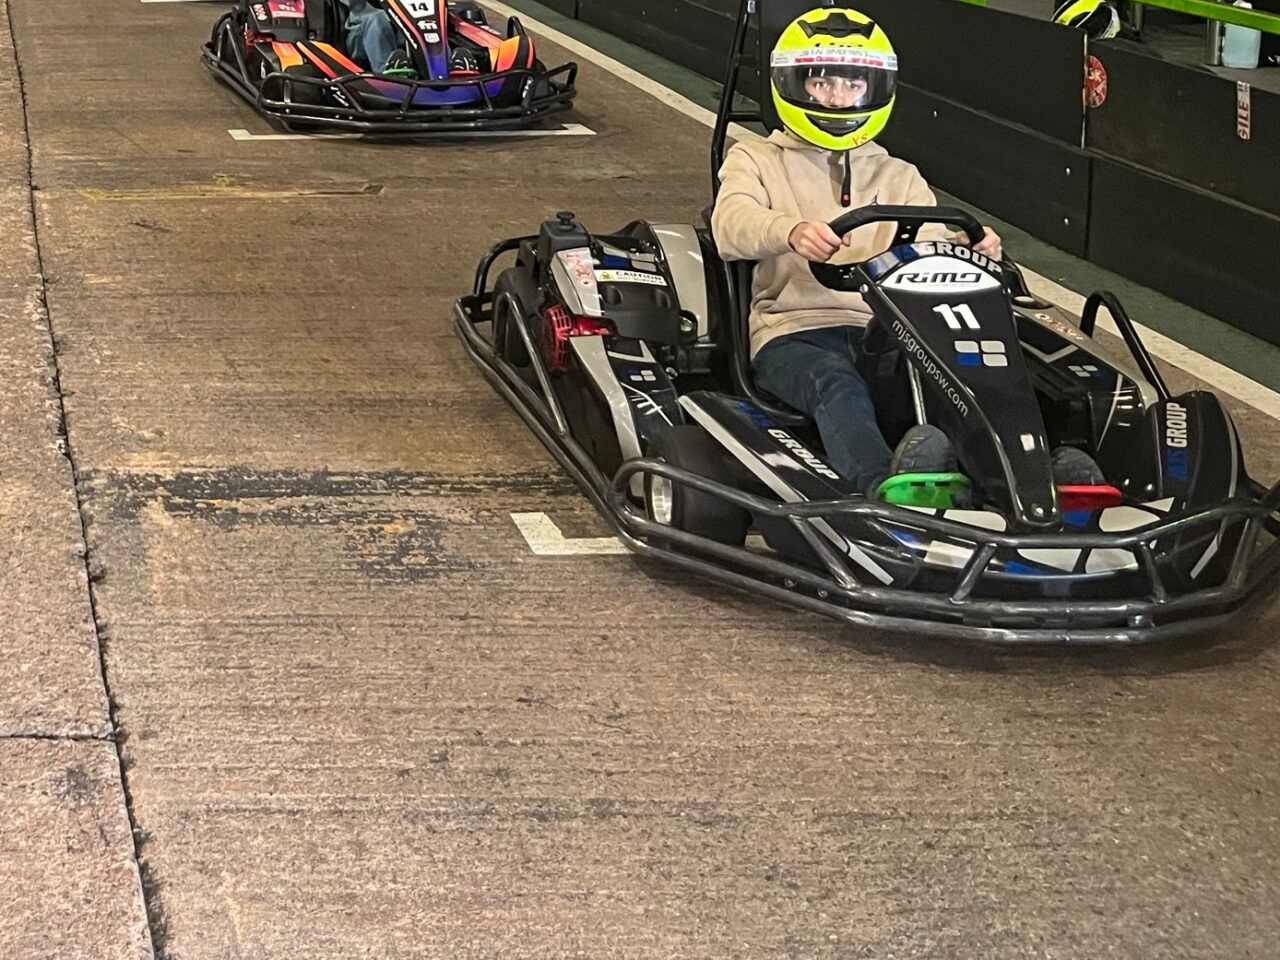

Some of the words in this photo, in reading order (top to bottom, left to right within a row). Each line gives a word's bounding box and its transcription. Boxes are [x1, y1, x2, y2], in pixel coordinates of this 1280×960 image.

[409, 2, 429, 12] 14
[912, 241, 1003, 274] GROUP
[932, 303, 981, 329] 11
[892, 319, 969, 418] mjsgroupsw.com
[1166, 402, 1188, 448] GROUP
[767, 428, 840, 480] GROUP
